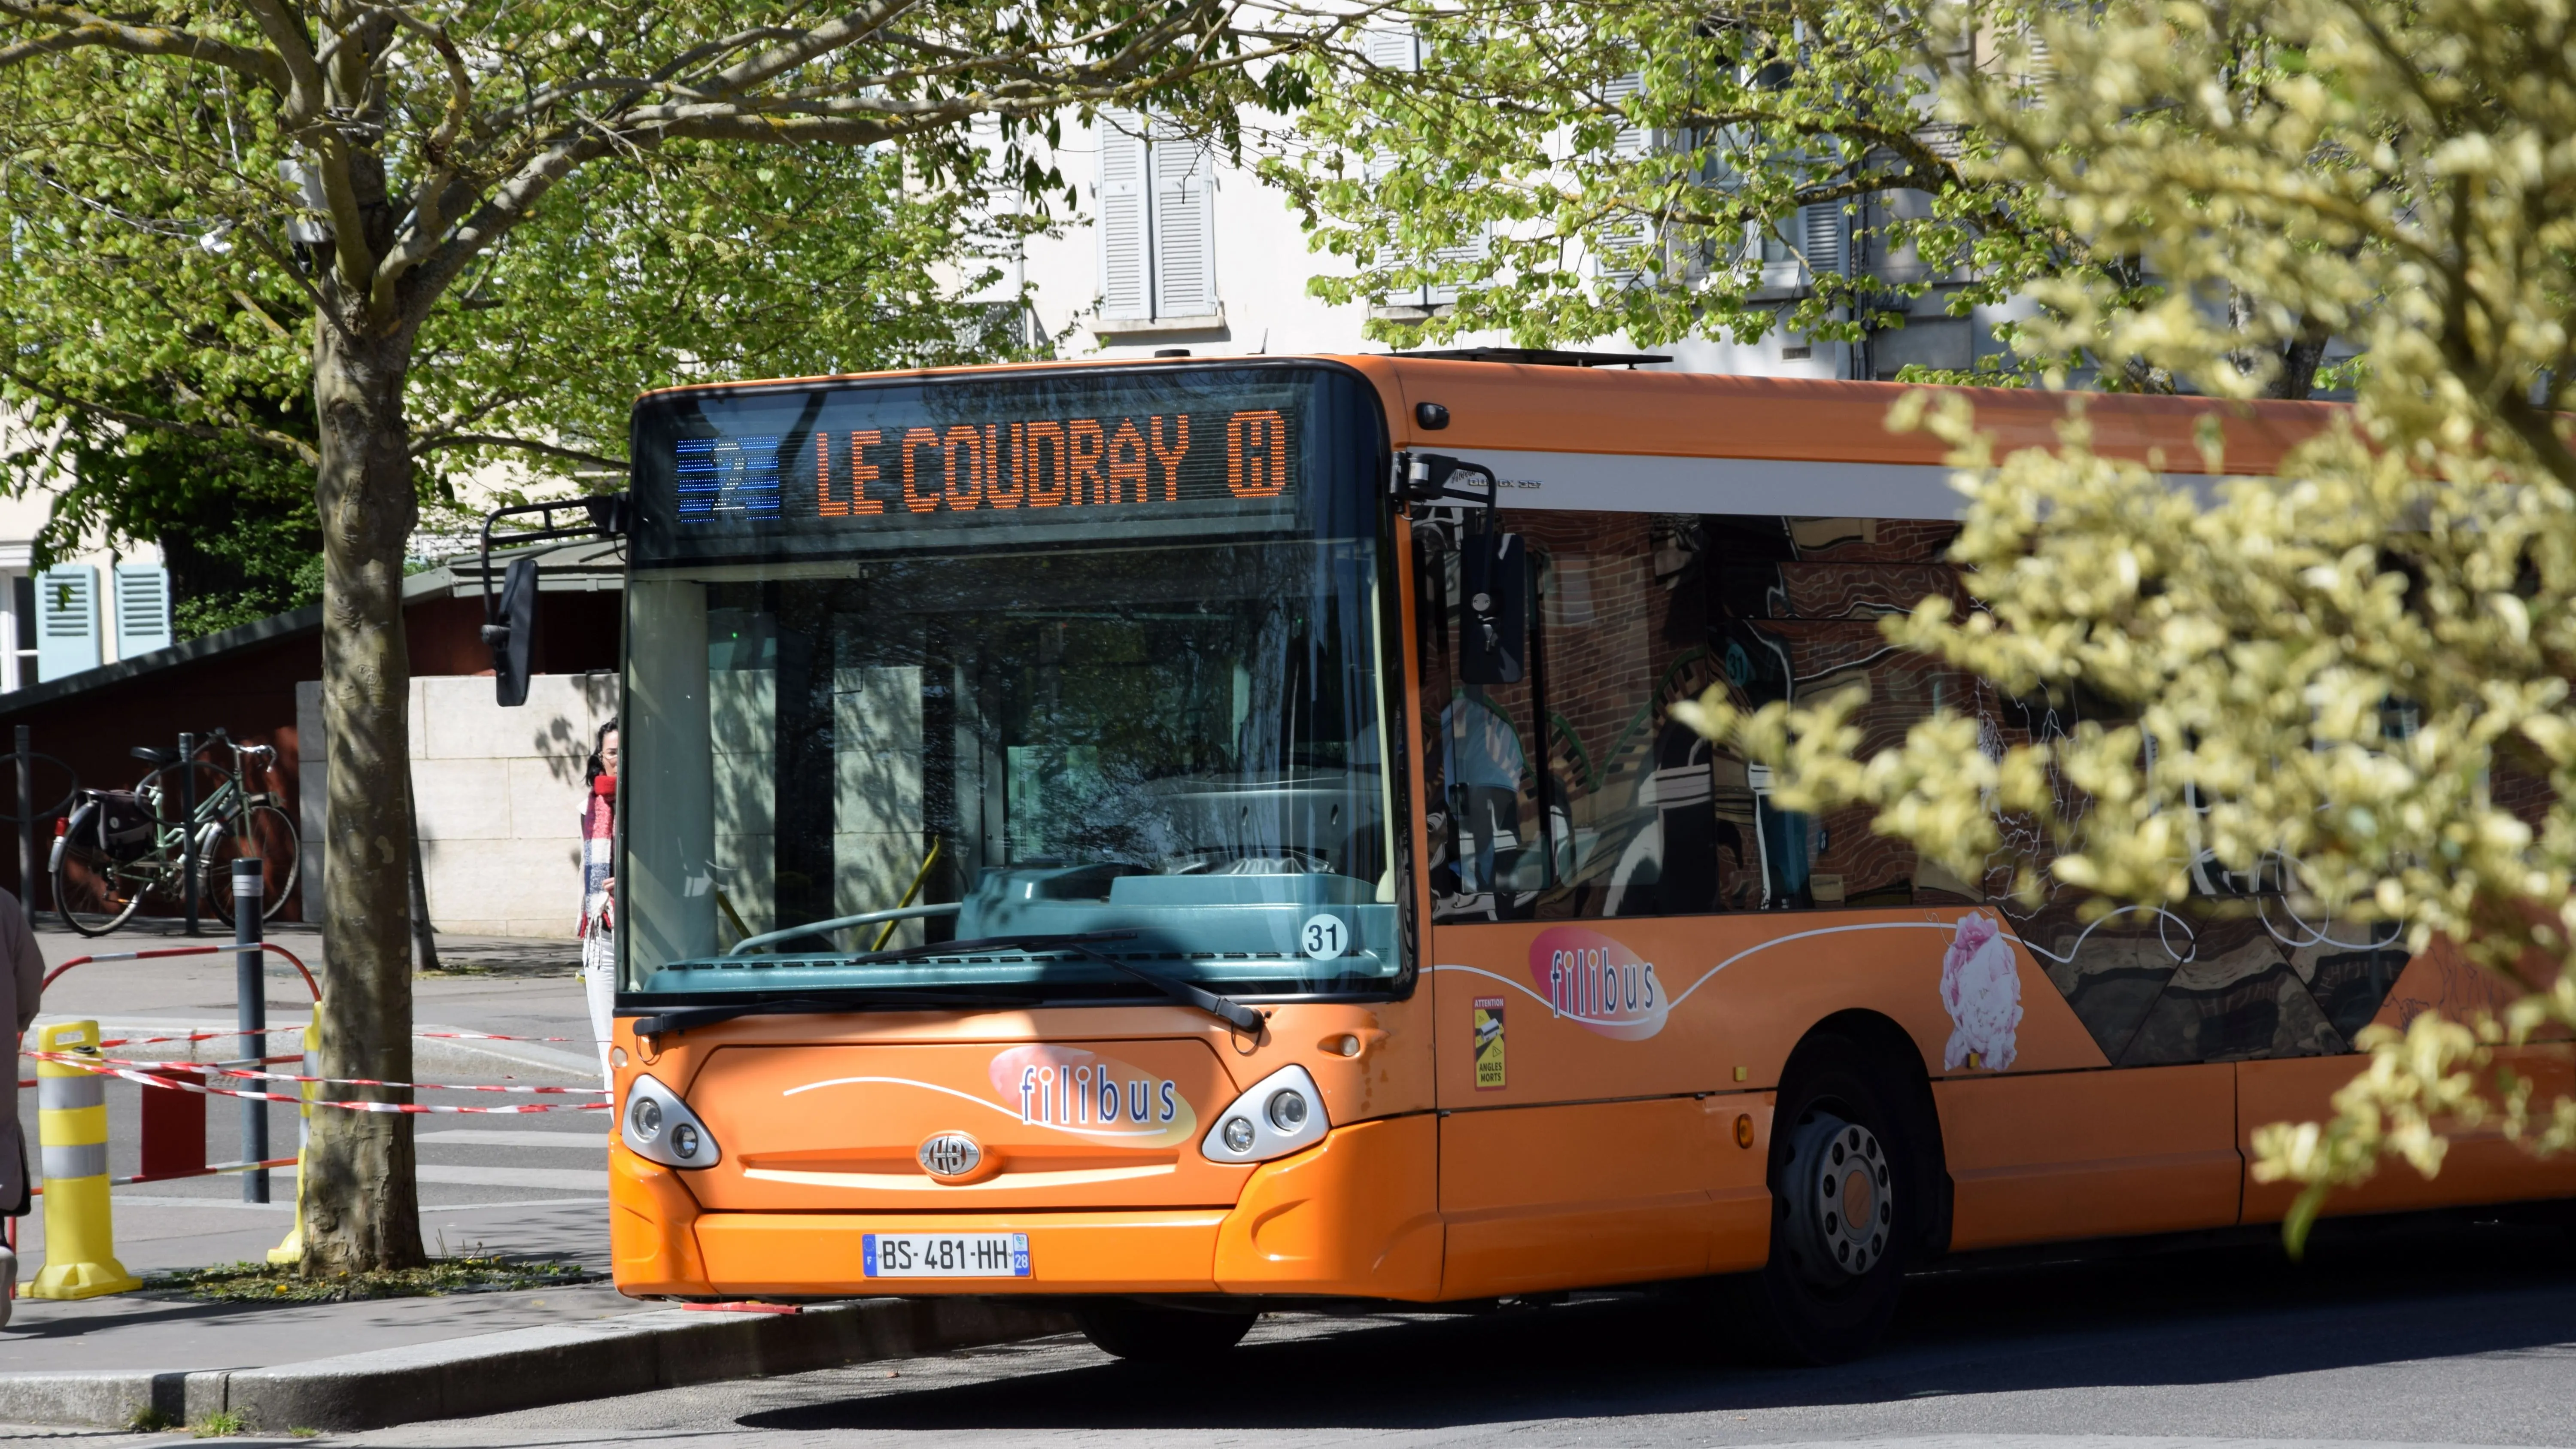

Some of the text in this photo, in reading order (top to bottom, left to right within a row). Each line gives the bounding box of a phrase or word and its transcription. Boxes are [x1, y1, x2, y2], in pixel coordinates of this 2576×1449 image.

[817, 430, 883, 516] LE
[902, 414, 1189, 513] COUDRAY
[713, 443, 745, 510] 2
[1518, 480, 1544, 489] 327
[1728, 653, 1744, 679] 31
[1308, 923, 1337, 952] 31
[1551, 947, 1654, 1018] filibus
[1474, 999, 1504, 1008] ATTENTION
[1479, 1062, 1502, 1072] ANGLES
[1480, 1072, 1501, 1082] MORTS
[1019, 1064, 1176, 1125] filibus
[867, 1256, 872, 1265] F
[1015, 1254, 1028, 1268] 28
